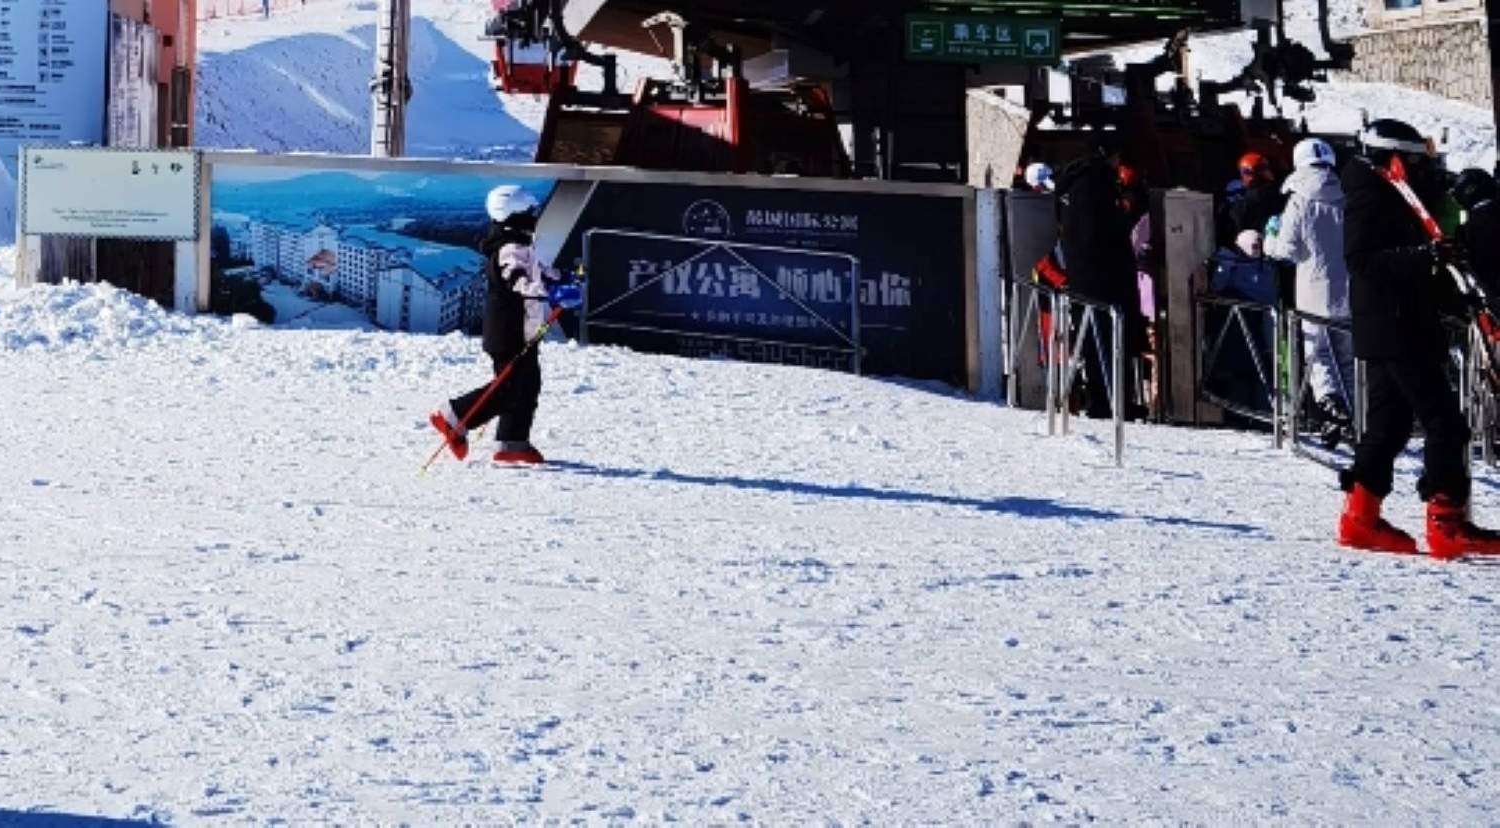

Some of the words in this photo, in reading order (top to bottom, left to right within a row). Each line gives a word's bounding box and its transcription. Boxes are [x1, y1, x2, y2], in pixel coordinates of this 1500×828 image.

[952, 23, 1013, 42] 乘车区
[628, 258, 762, 299] 产权公寓
